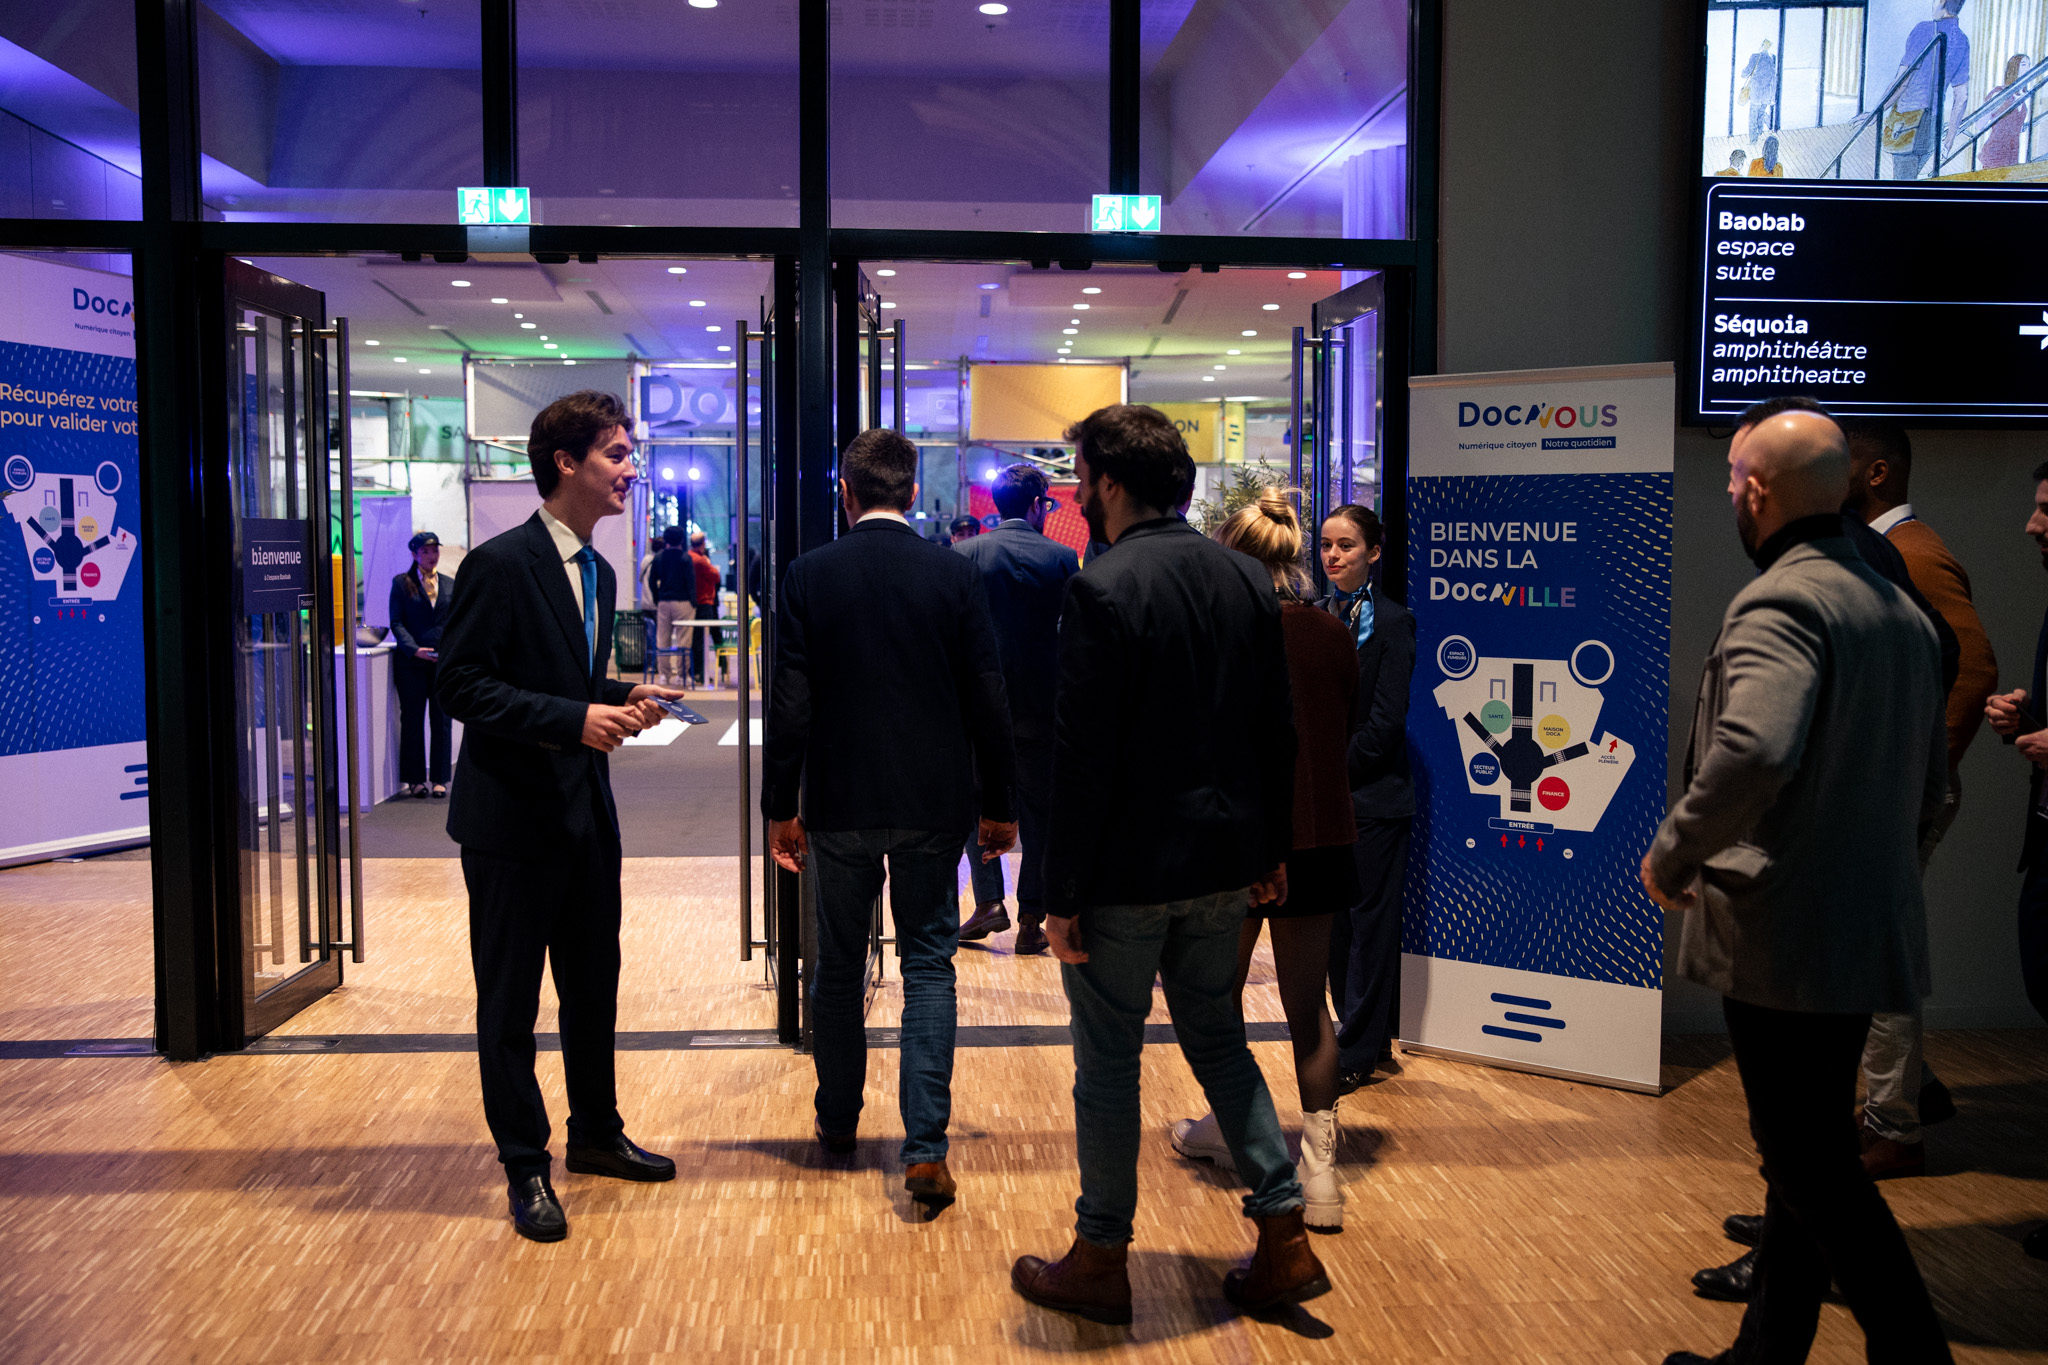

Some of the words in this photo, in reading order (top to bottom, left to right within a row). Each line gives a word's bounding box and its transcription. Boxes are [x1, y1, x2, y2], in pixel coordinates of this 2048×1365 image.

[1718, 211, 1806, 232] Baobab
[1716, 239, 1795, 258] espace
[1715, 262, 1776, 281] suite
[74, 322, 109, 334] Numérique
[109, 327, 131, 337] citoyen
[1714, 314, 1809, 337] Séquoia
[1712, 340, 1867, 362] amphithéâtre
[1711, 364, 1866, 386] amphitheatre
[0, 383, 96, 410] Récupérez
[1, 410, 45, 428] pour
[49, 412, 108, 433] valider
[1458, 441, 1505, 451] Numérique
[1506, 440, 1537, 450] citoyen
[1545, 439, 1570, 448] Notre
[1571, 438, 1613, 449] quotidien
[1430, 522, 1577, 542] BIENVENUE
[252, 546, 301, 565] bienvenue
[1430, 549, 1498, 568] DANS
[1506, 549, 1538, 569] LA
[1508, 821, 1535, 830] ENTRÉE
